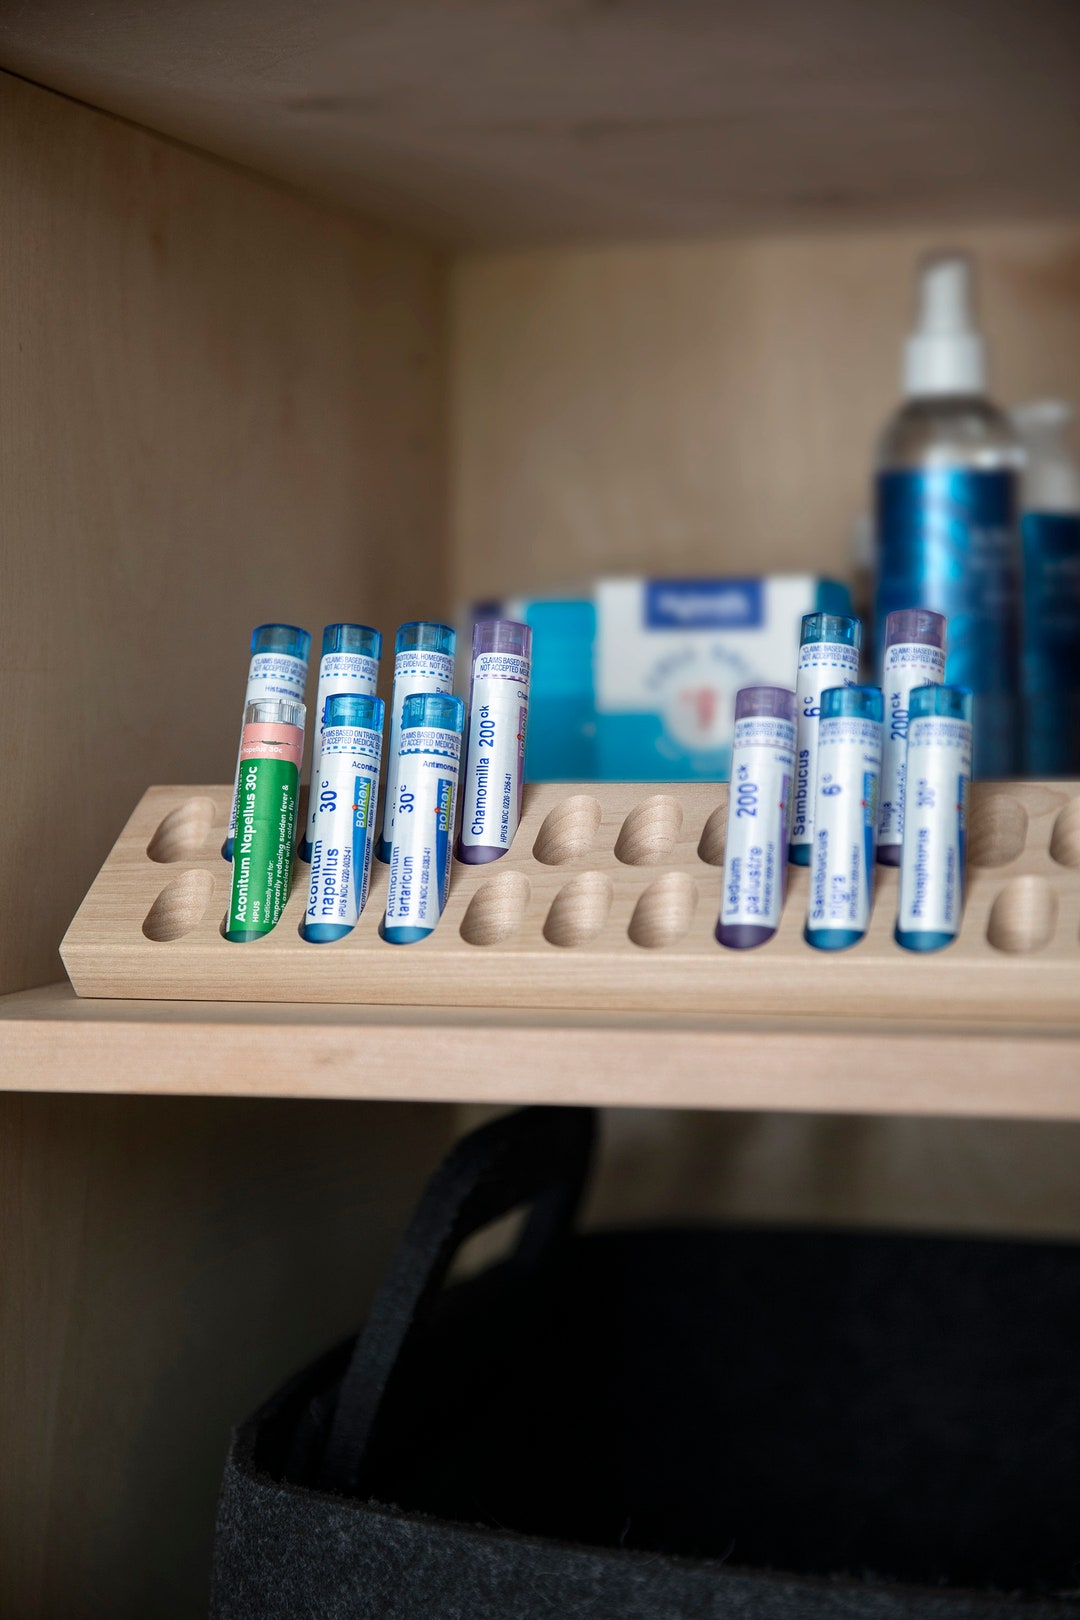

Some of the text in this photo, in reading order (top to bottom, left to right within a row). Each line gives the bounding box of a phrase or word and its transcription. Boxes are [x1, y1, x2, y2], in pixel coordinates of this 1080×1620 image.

[262, 664, 289, 673] ACCEPTED
[334, 664, 361, 672] ACCEPTED
[345, 656, 363, 664] BASED
[430, 661, 440, 669] NOT
[480, 663, 490, 671] NOT
[491, 664, 519, 673] ACCEPTED
[503, 657, 520, 666] BASED
[327, 737, 352, 745] ACCEPTED
[353, 738, 375, 749] MEDICAL
[407, 739, 434, 747] ACCEPTED
[416, 731, 435, 739] BASED
[280, 793, 288, 813] fever
[471, 757, 490, 836] Chamomilla
[793, 748, 810, 836] Sambucus
[279, 813, 287, 842] sudden
[501, 809, 510, 825] NDC
[879, 800, 897, 836] Thuja
[235, 766, 258, 922] Aconitum Napellus 30c
[363, 837, 372, 872] MEDICINE
[368, 809, 376, 828] Made
[500, 824, 510, 843] HPUS
[276, 843, 286, 878] reducing
[282, 859, 290, 902] associated
[308, 840, 323, 917] Aconitum
[321, 848, 339, 916] napellus
[387, 846, 400, 918] Antimonium
[725, 856, 740, 915] Ledum
[812, 829, 828, 919] Sambucus
[340, 884, 349, 899] NDC
[397, 856, 414, 917] tartaricum
[420, 886, 429, 900] NDC
[252, 900, 260, 923] HPUS
[263, 887, 274, 924] Traditionally
[272, 879, 283, 924] Temporarily
[339, 899, 348, 918] HPUS
[418, 900, 427, 919] HPUS
